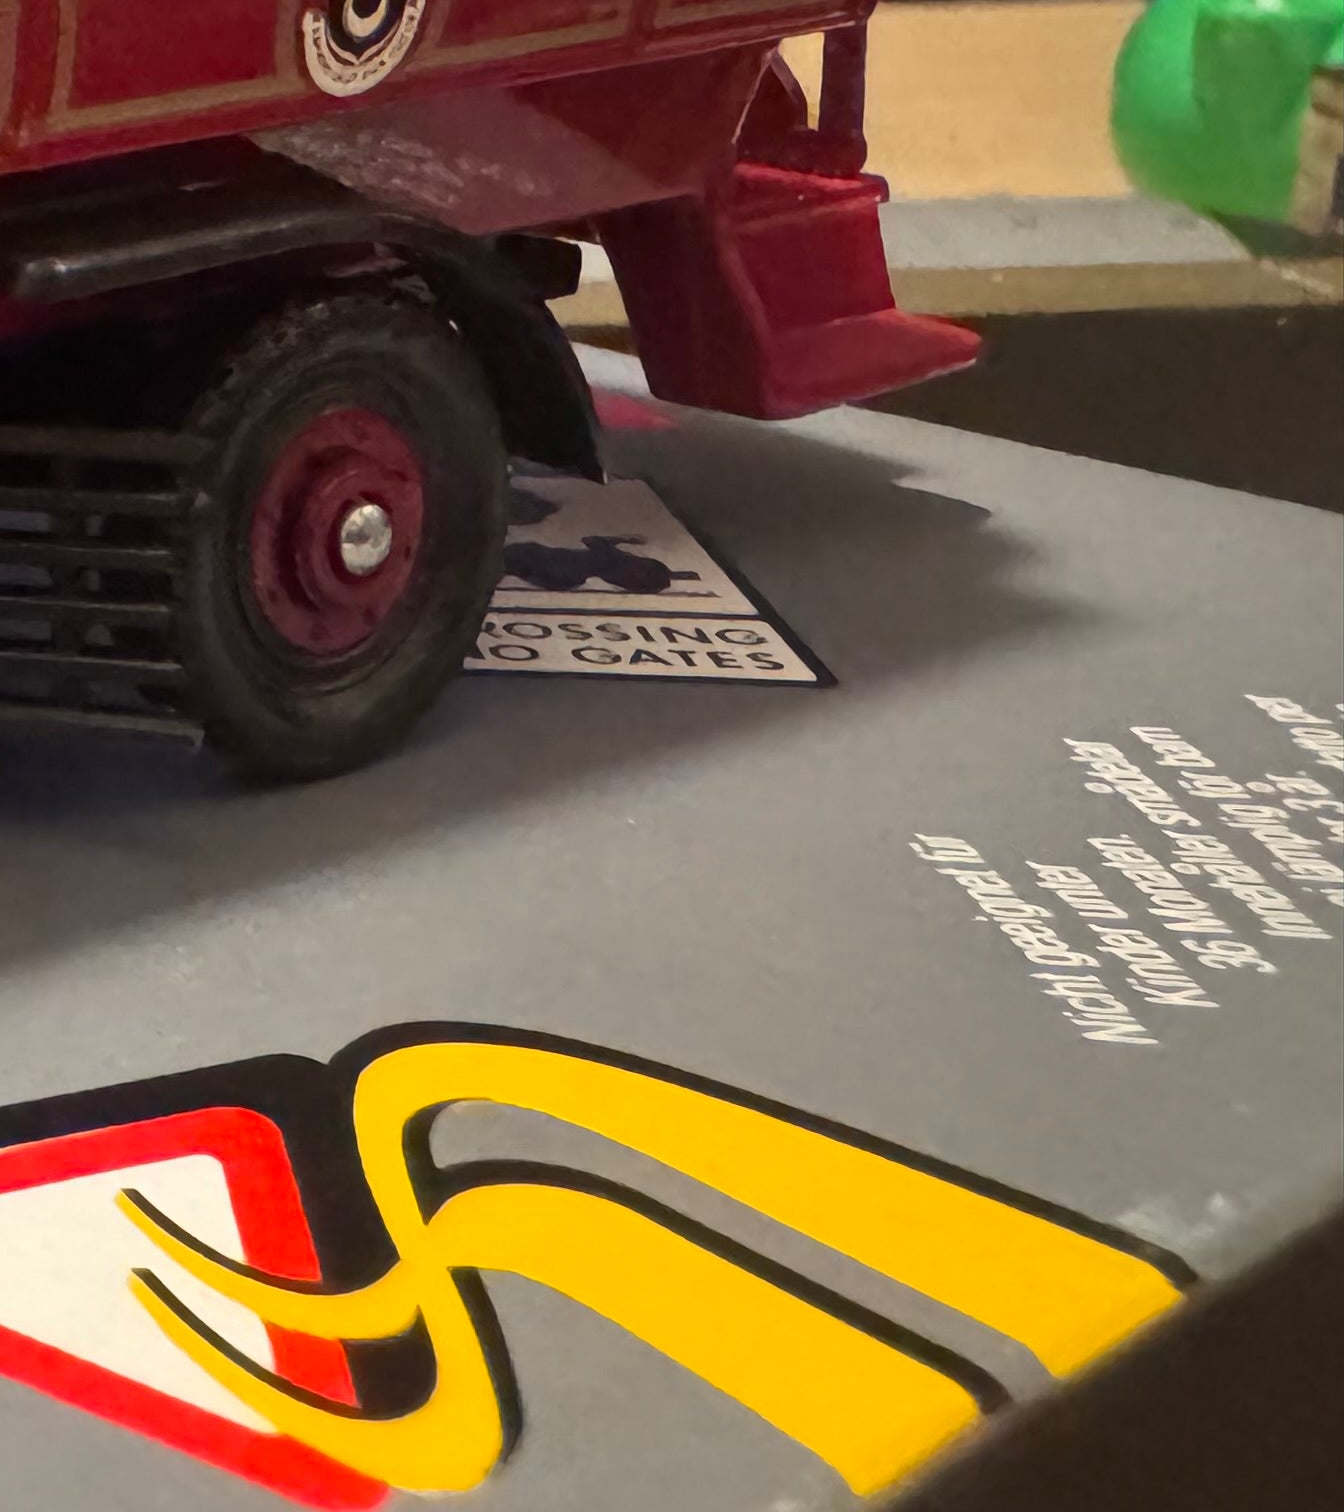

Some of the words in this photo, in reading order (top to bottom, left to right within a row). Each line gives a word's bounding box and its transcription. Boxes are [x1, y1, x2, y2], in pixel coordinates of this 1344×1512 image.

[471, 644, 539, 661] O
[571, 645, 786, 672] GATES
[934, 866, 1102, 968] geeignet
[1025, 860, 1129, 920] unter
[1087, 923, 1221, 1008] Kinder
[1179, 939, 1279, 975] 36
[1028, 972, 1160, 1045] Nicht
